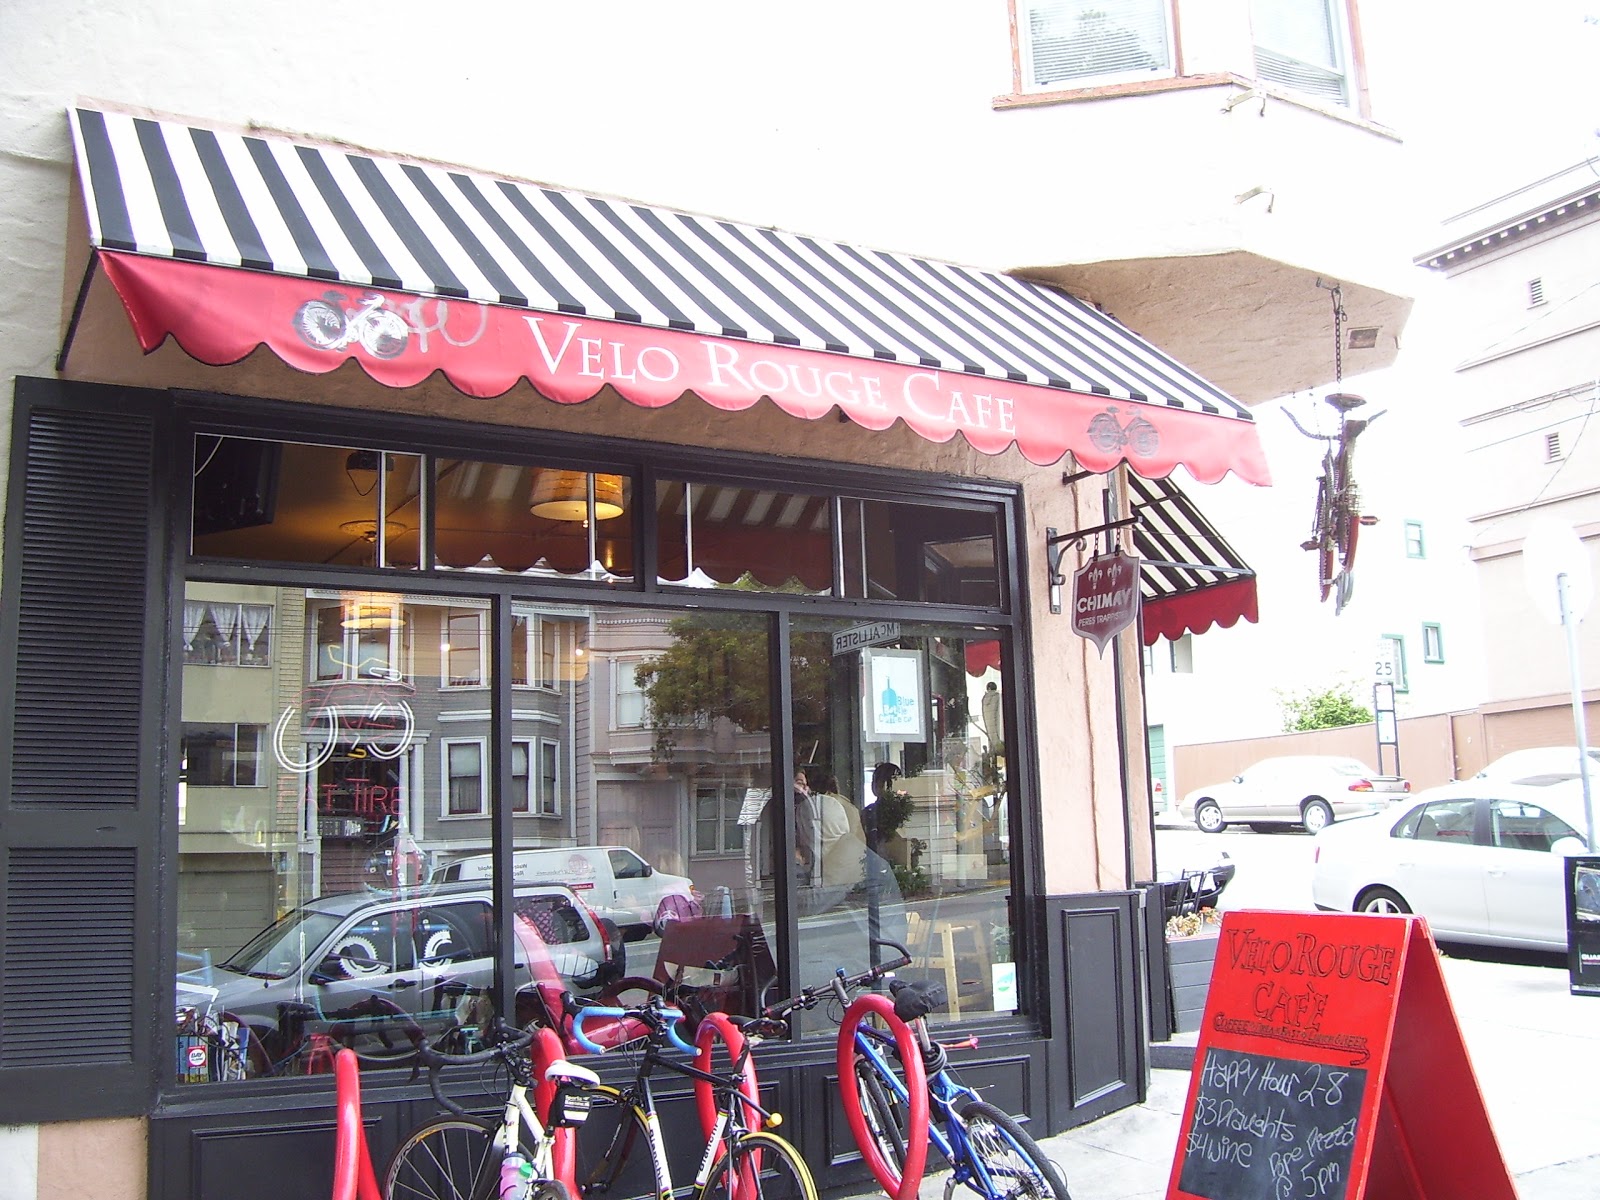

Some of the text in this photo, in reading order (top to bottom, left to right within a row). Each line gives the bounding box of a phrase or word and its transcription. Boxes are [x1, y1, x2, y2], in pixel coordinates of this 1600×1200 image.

[522, 315, 680, 384] VELO
[700, 340, 882, 411] ROUGE
[902, 371, 1017, 437] CAFE
[1077, 587, 1131, 613] CHIMAY
[1374, 661, 1393, 675] 25
[345, 778, 405, 815] TIRE
[1227, 928, 1396, 986] VELO ROUGE
[1201, 1050, 1349, 1107] Happy Hour 2-8
